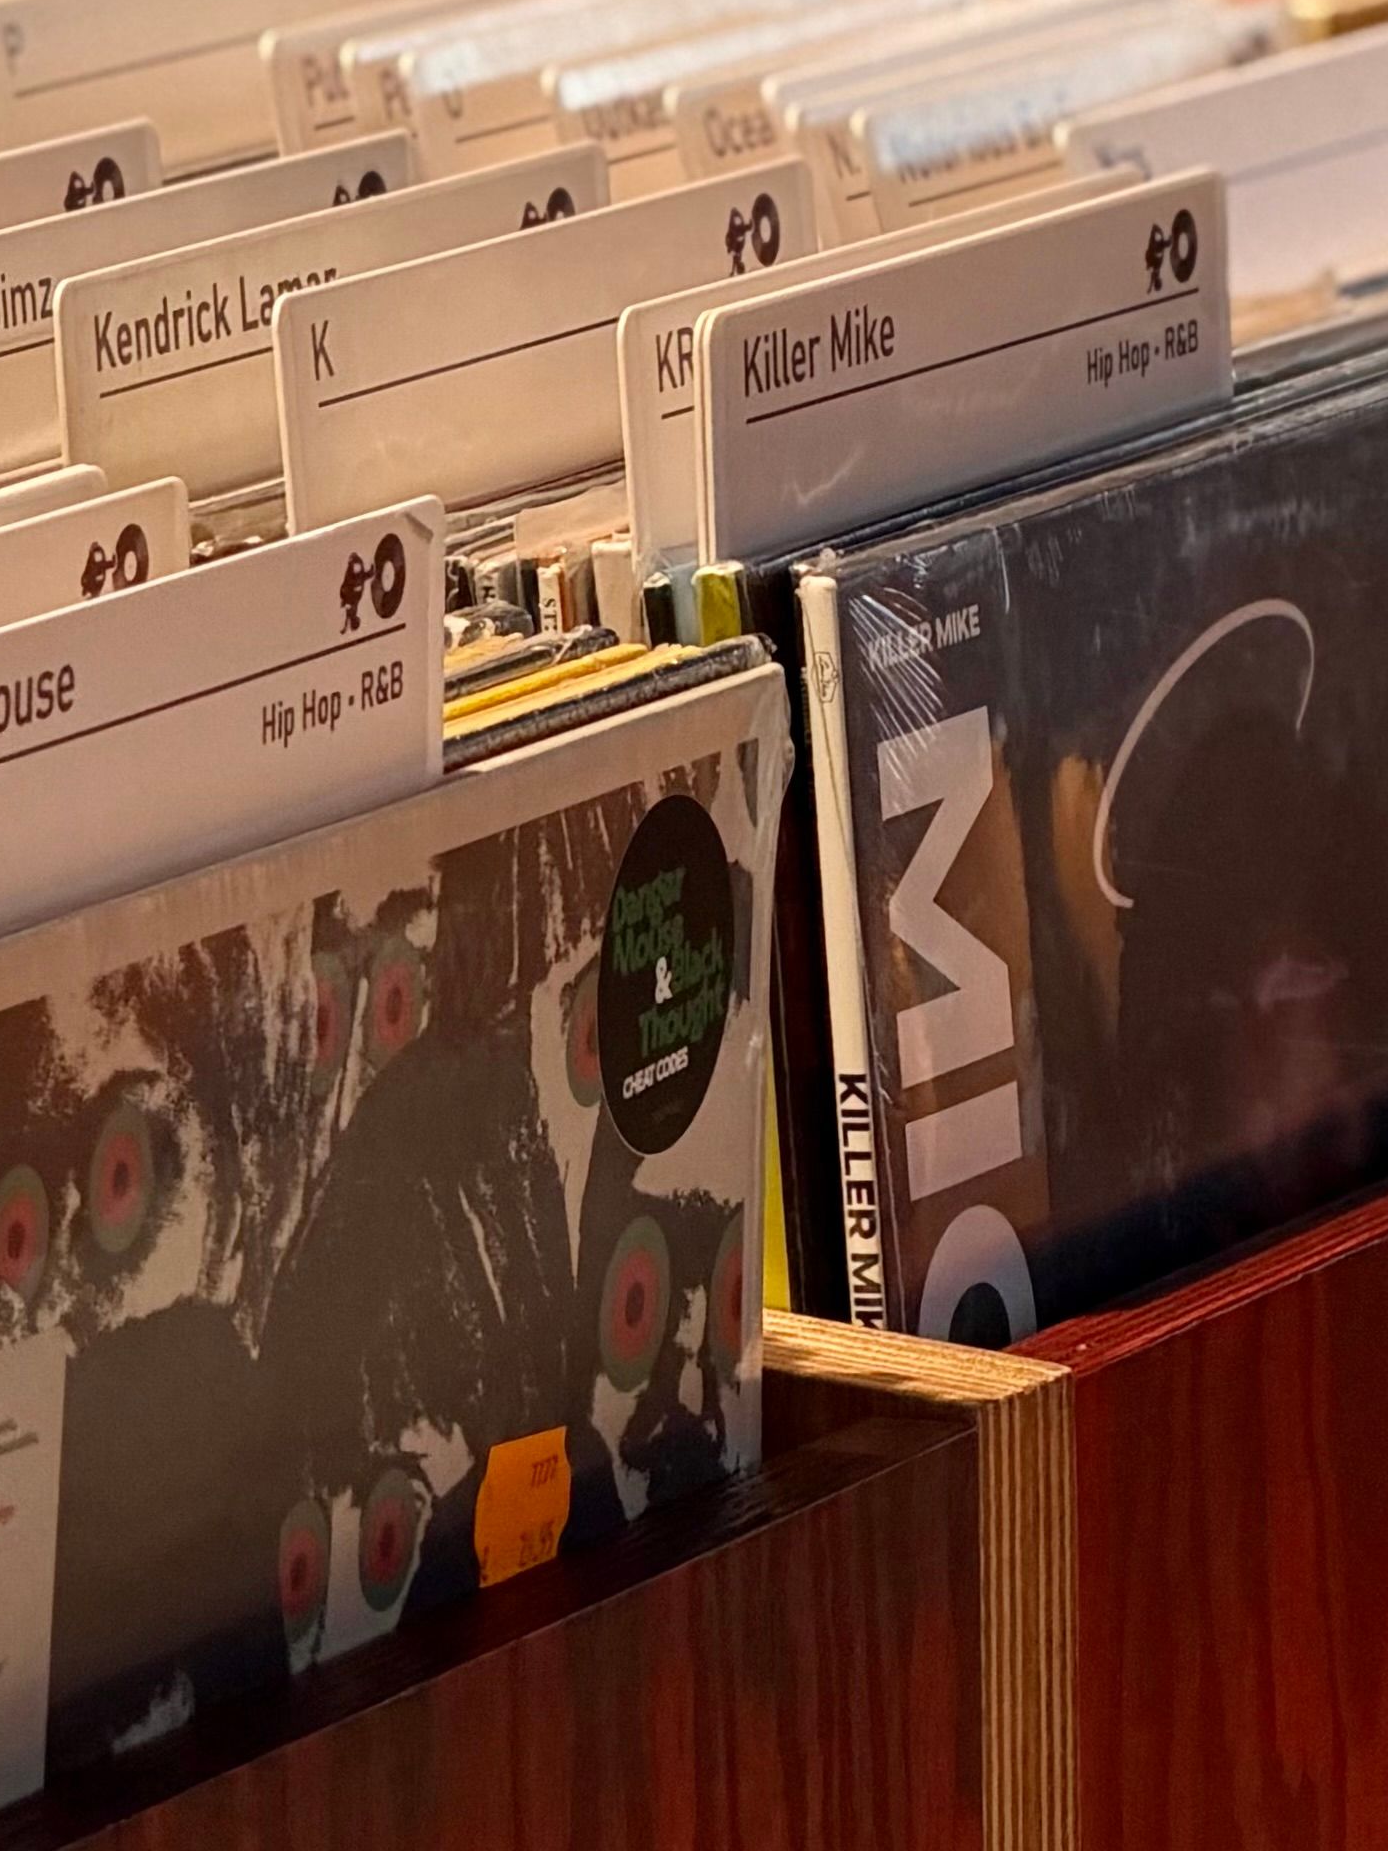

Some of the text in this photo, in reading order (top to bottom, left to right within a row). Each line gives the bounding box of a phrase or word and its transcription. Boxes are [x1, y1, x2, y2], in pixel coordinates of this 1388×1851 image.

[94, 281, 232, 372] Kendrick
[311, 319, 335, 381] K
[656, 325, 695, 393] KR
[743, 303, 895, 398] Killer Mike
[1087, 318, 1199, 389] Hip Hop R&B
[935, 603, 981, 649] MIKE
[262, 660, 404, 749] Hip Hop R&B
[655, 955, 674, 1005] &
[622, 1045, 690, 1099] CHEAT CODES
[838, 1074, 876, 1240] KILLER
